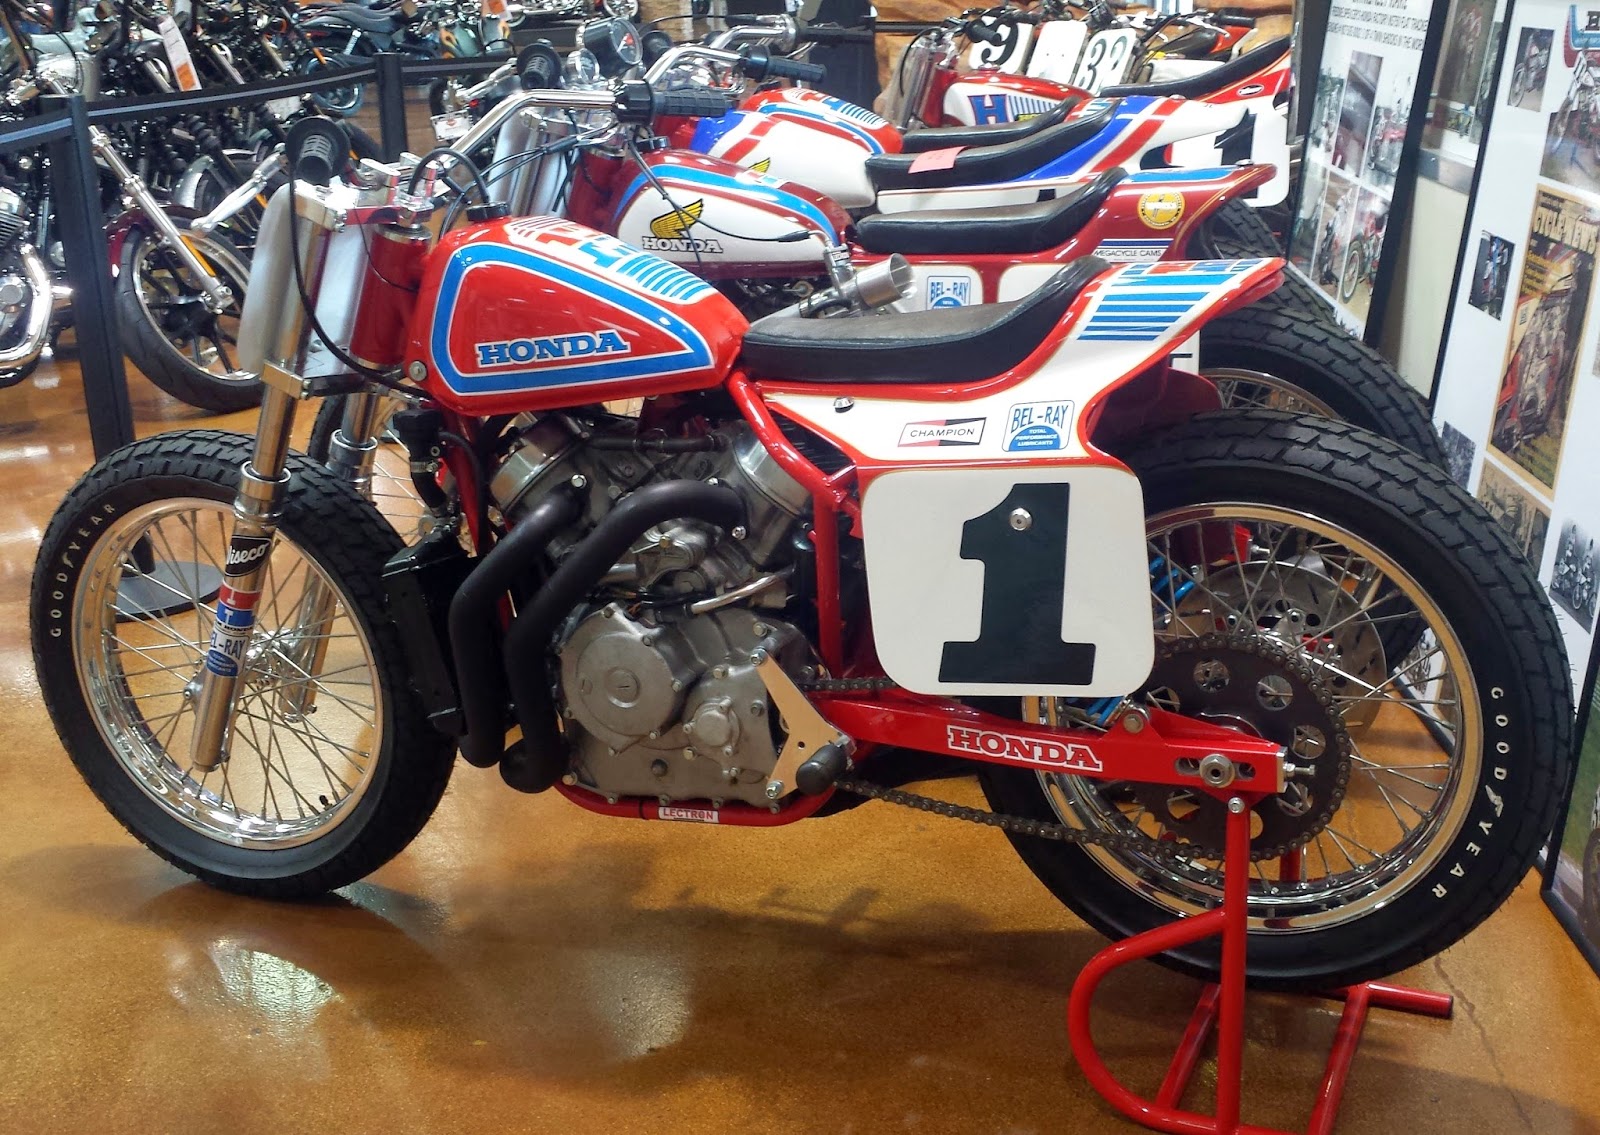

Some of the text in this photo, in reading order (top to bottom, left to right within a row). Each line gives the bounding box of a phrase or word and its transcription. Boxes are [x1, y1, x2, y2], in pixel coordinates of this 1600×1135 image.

[641, 236, 724, 253] HONDA
[476, 329, 631, 367] HONDA
[910, 428, 975, 438] CHAMPION
[938, 482, 1096, 686] 1
[211, 631, 246, 660] EL-RAY
[947, 724, 1104, 773] HONDA
[662, 807, 714, 820] LECTRON
